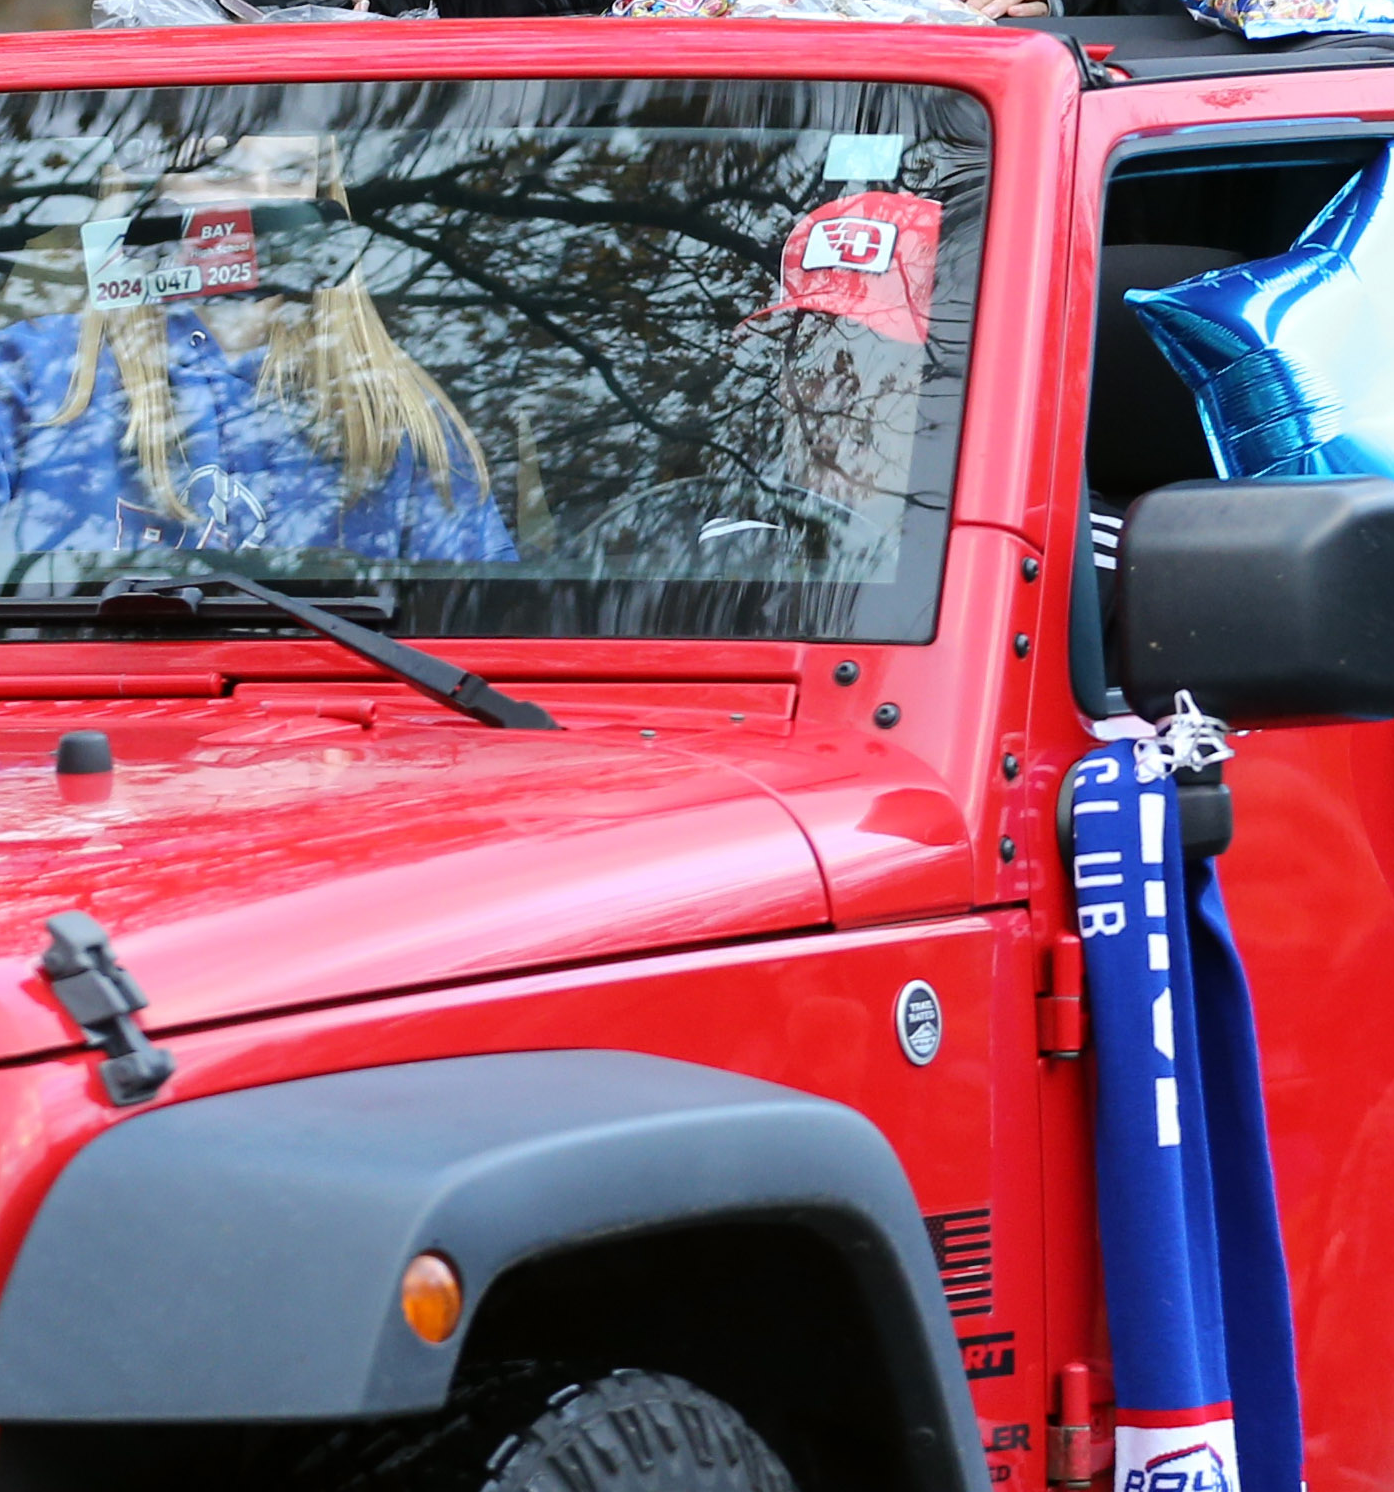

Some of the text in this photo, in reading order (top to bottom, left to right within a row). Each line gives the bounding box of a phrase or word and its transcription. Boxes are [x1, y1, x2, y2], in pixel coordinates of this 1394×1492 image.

[200, 221, 236, 240] BAY
[96, 262, 252, 302] 2024 047 2025
